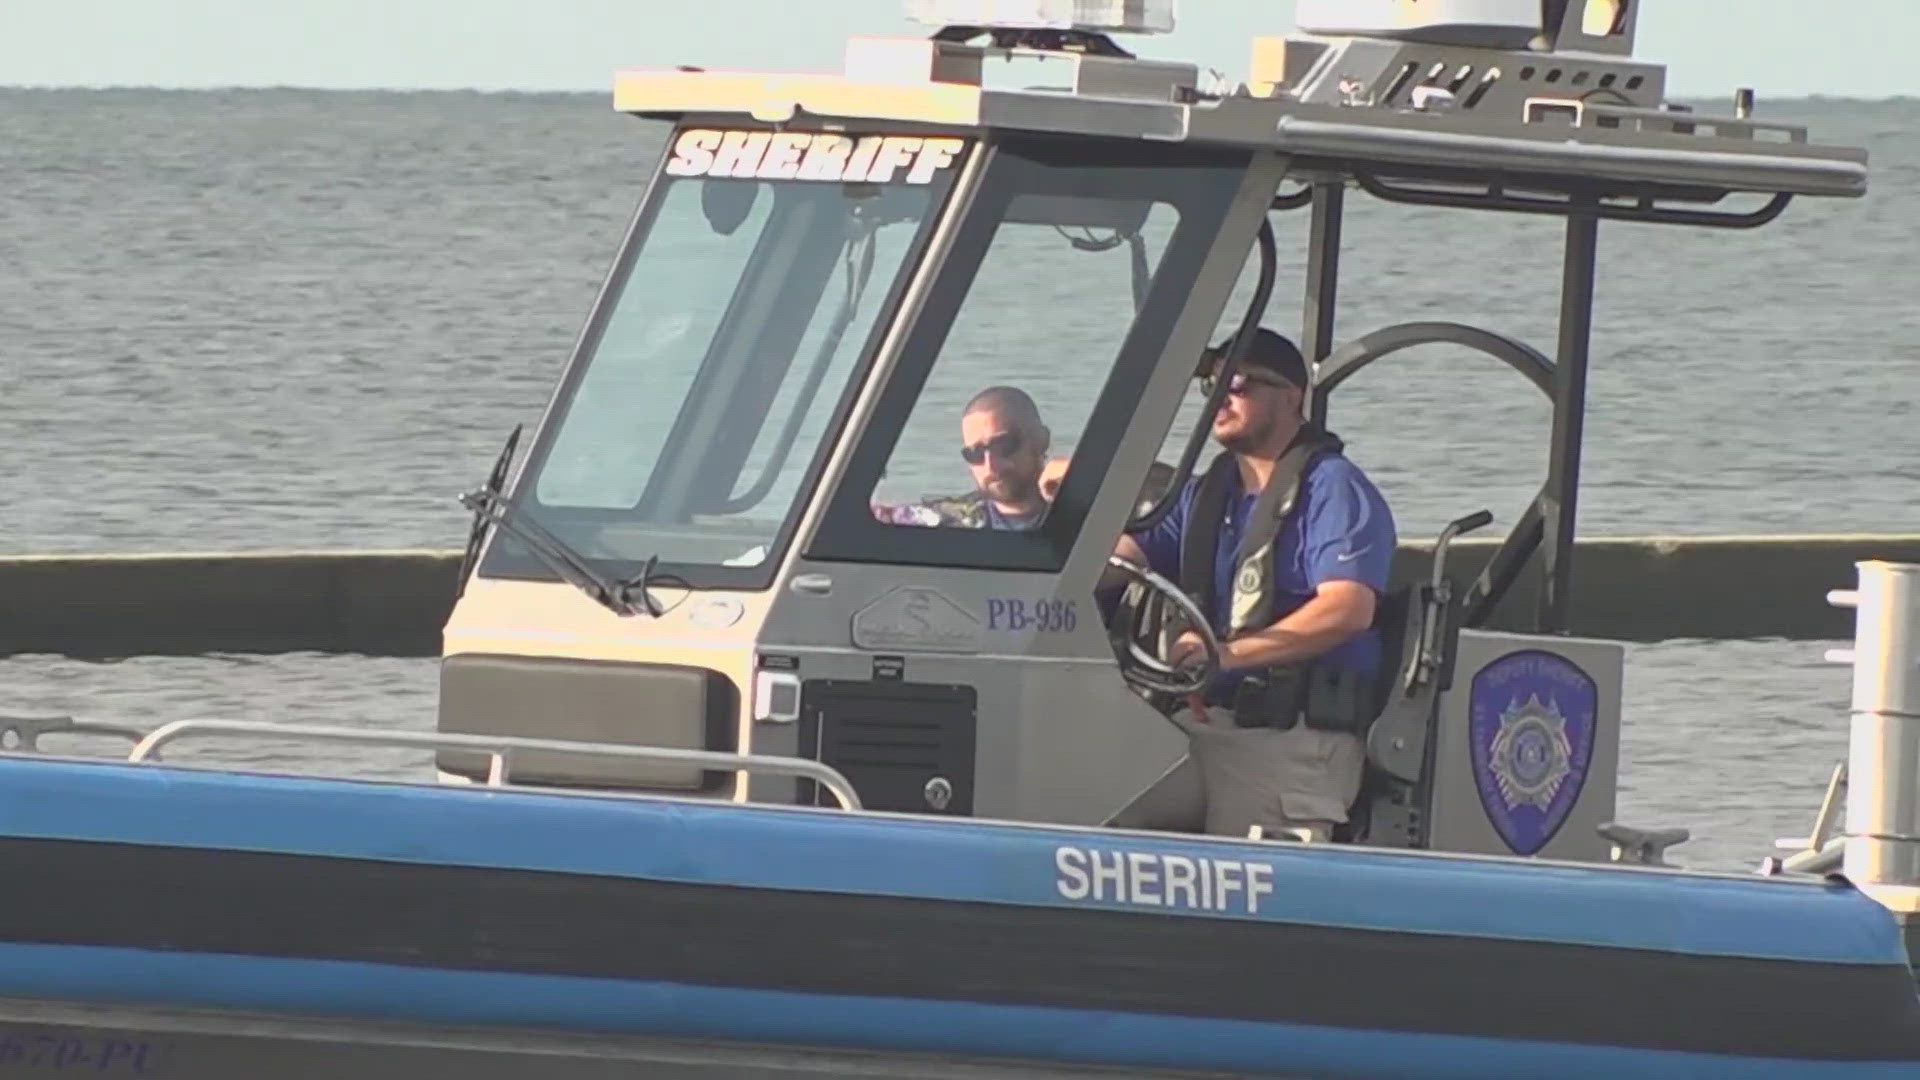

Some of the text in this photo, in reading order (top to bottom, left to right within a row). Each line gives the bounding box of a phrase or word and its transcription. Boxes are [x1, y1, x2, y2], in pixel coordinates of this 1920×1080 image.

[666, 129, 963, 184] SHERIFF
[986, 598, 1077, 633] PB-936
[1056, 846, 1274, 913] SHERIFF
